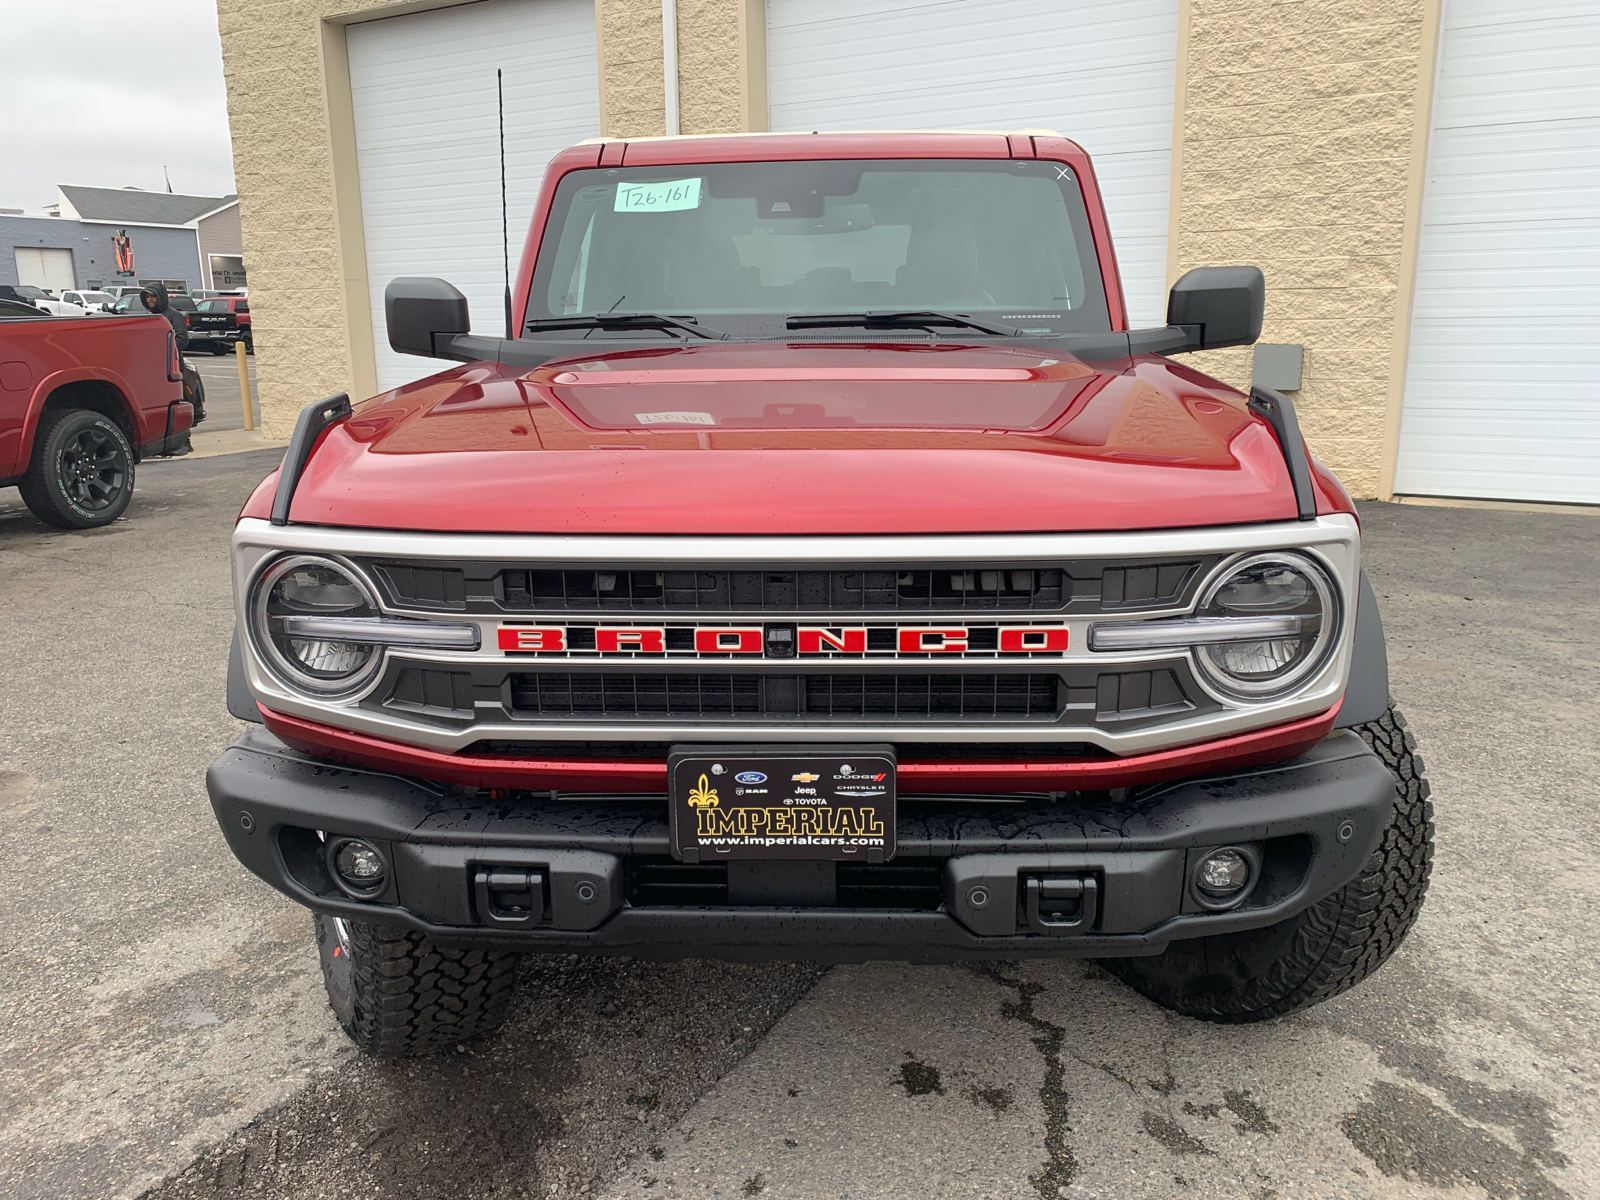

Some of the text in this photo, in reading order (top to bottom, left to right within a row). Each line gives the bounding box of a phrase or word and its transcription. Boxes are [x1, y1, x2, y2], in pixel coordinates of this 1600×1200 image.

[621, 185, 690, 207] T26-161
[497, 625, 1070, 653] BRONCO
[741, 774, 761, 782] Ford
[794, 786, 816, 795] Jeep
[697, 808, 884, 836] IMPERIAL
[697, 836, 885, 847] www.imperialcars.com
